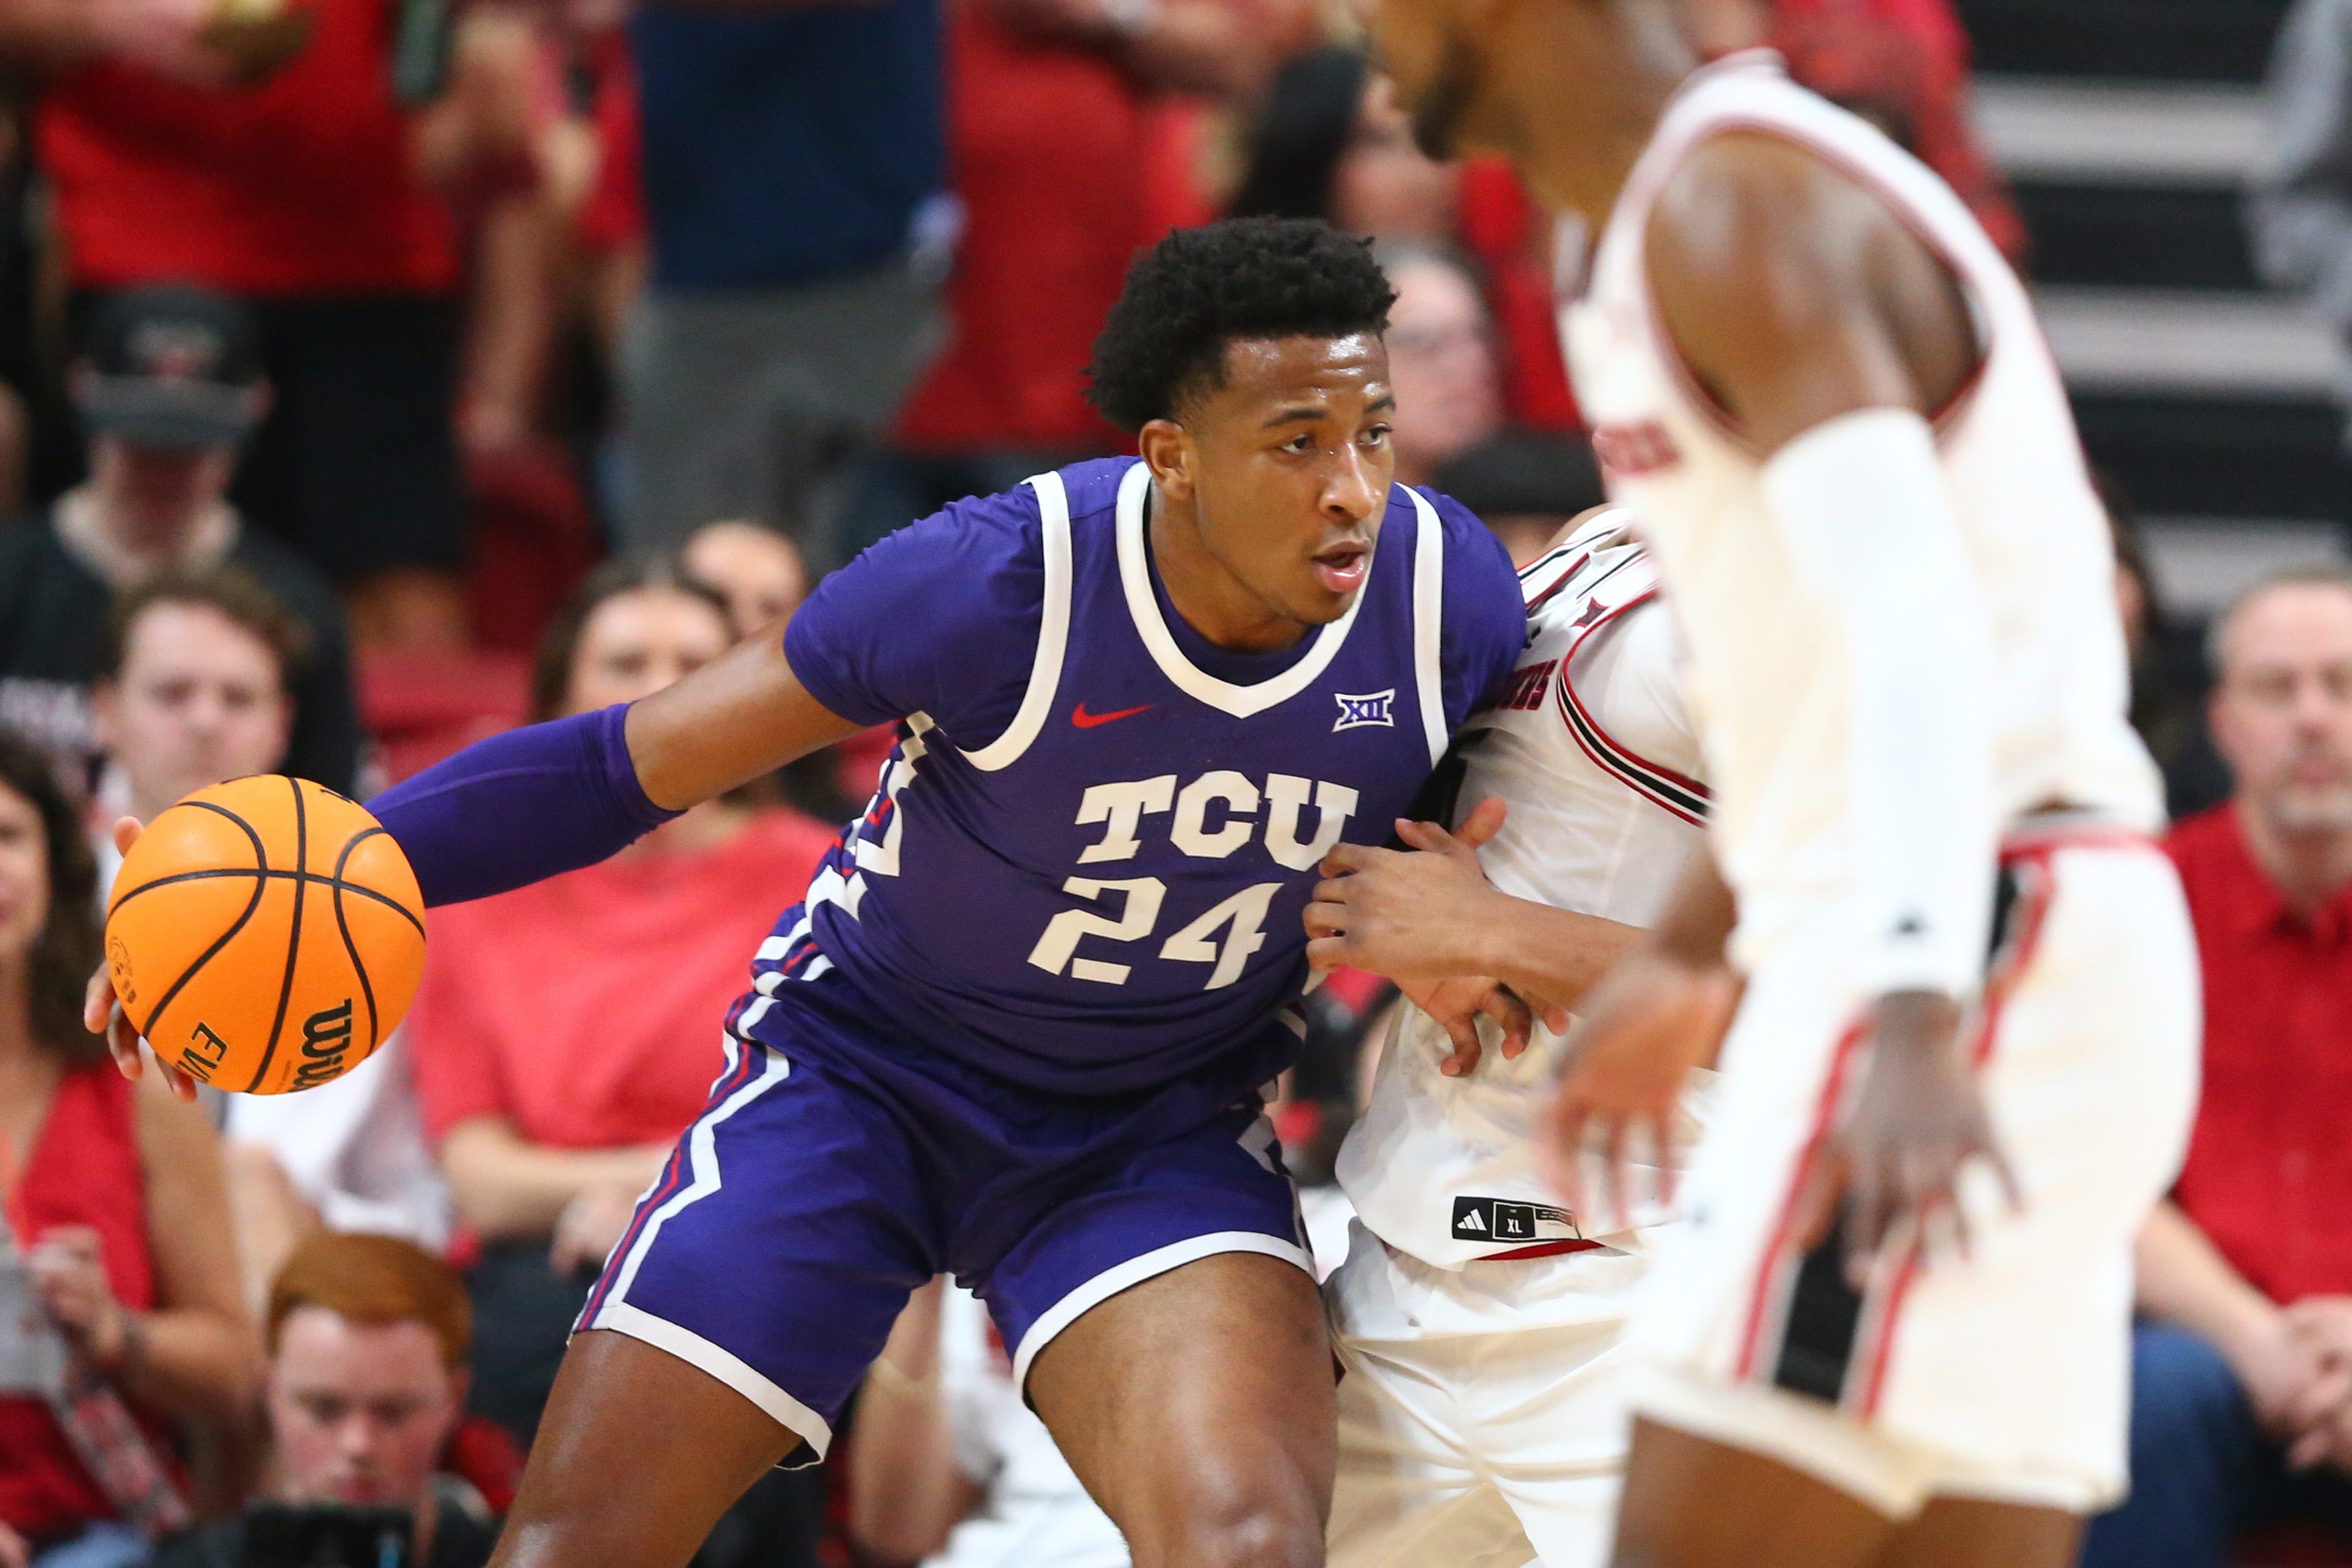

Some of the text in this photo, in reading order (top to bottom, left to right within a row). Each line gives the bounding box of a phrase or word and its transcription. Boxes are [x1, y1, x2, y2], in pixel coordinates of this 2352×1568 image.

[1339, 694, 1390, 727] XII
[1075, 770, 1359, 872] TCU
[1028, 876, 1285, 990] 24
[174, 1021, 227, 1082] EV
[288, 997, 352, 1092] Wil
[1507, 1218, 1523, 1233] XL
